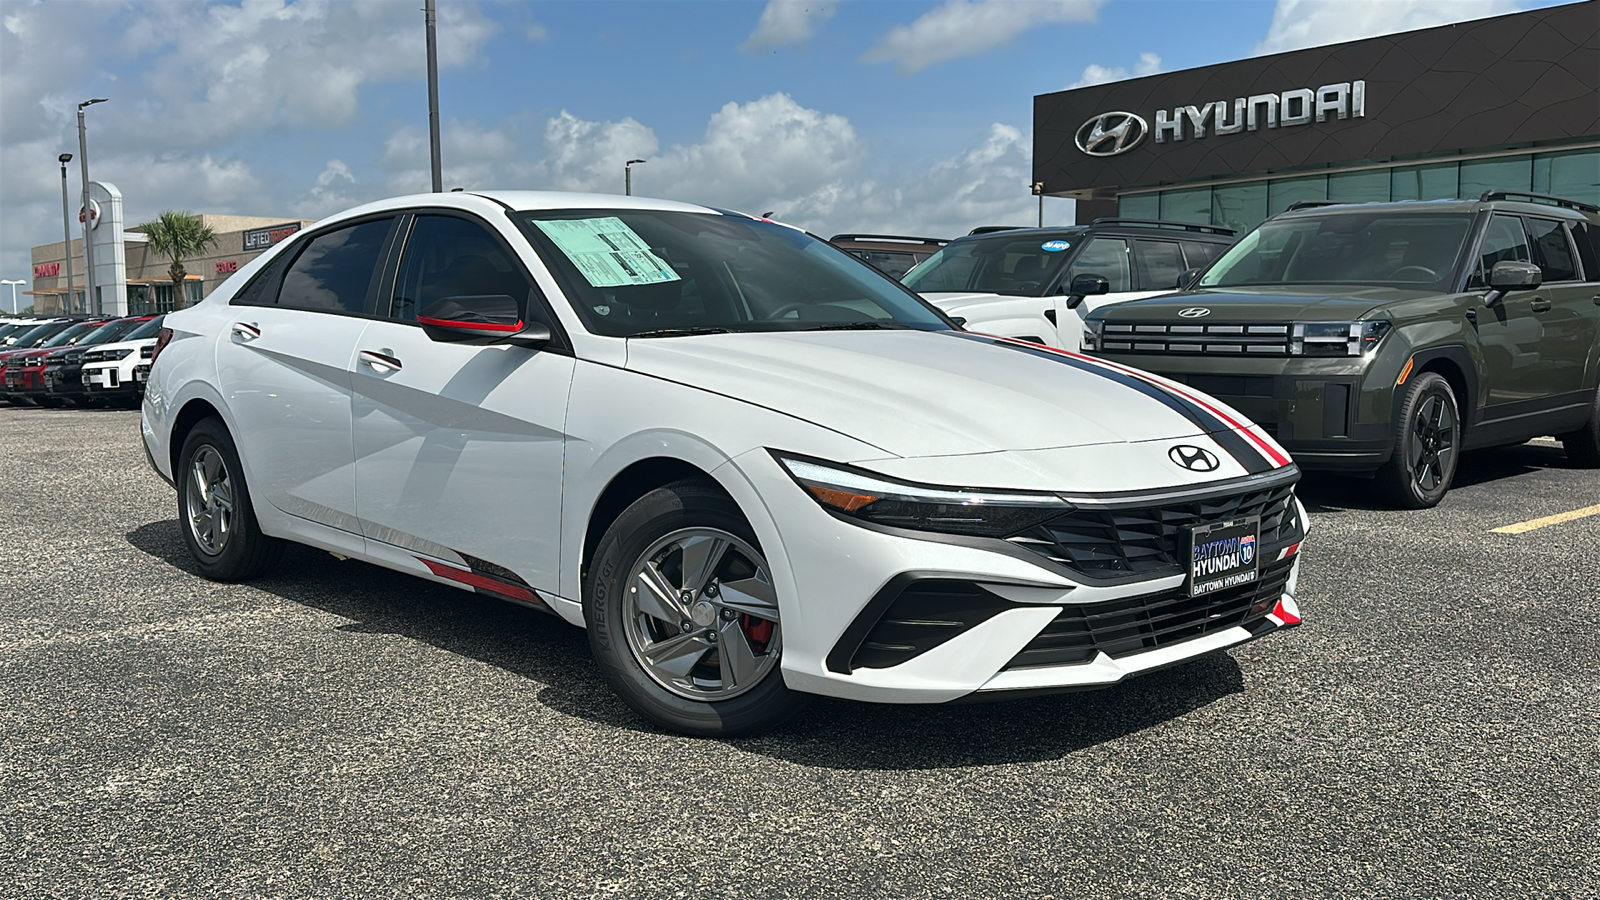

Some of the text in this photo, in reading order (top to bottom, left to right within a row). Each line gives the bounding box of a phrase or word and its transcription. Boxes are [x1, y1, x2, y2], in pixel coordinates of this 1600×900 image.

[1155, 80, 1366, 144] HYUNDAI
[245, 231, 270, 247] LIFTED
[1194, 537, 1240, 561] BAYTOWN
[1243, 546, 1252, 560] 10
[1193, 552, 1240, 577] HYUNDAI
[1194, 572, 1250, 594] BAYTOWN HYUNDAI
